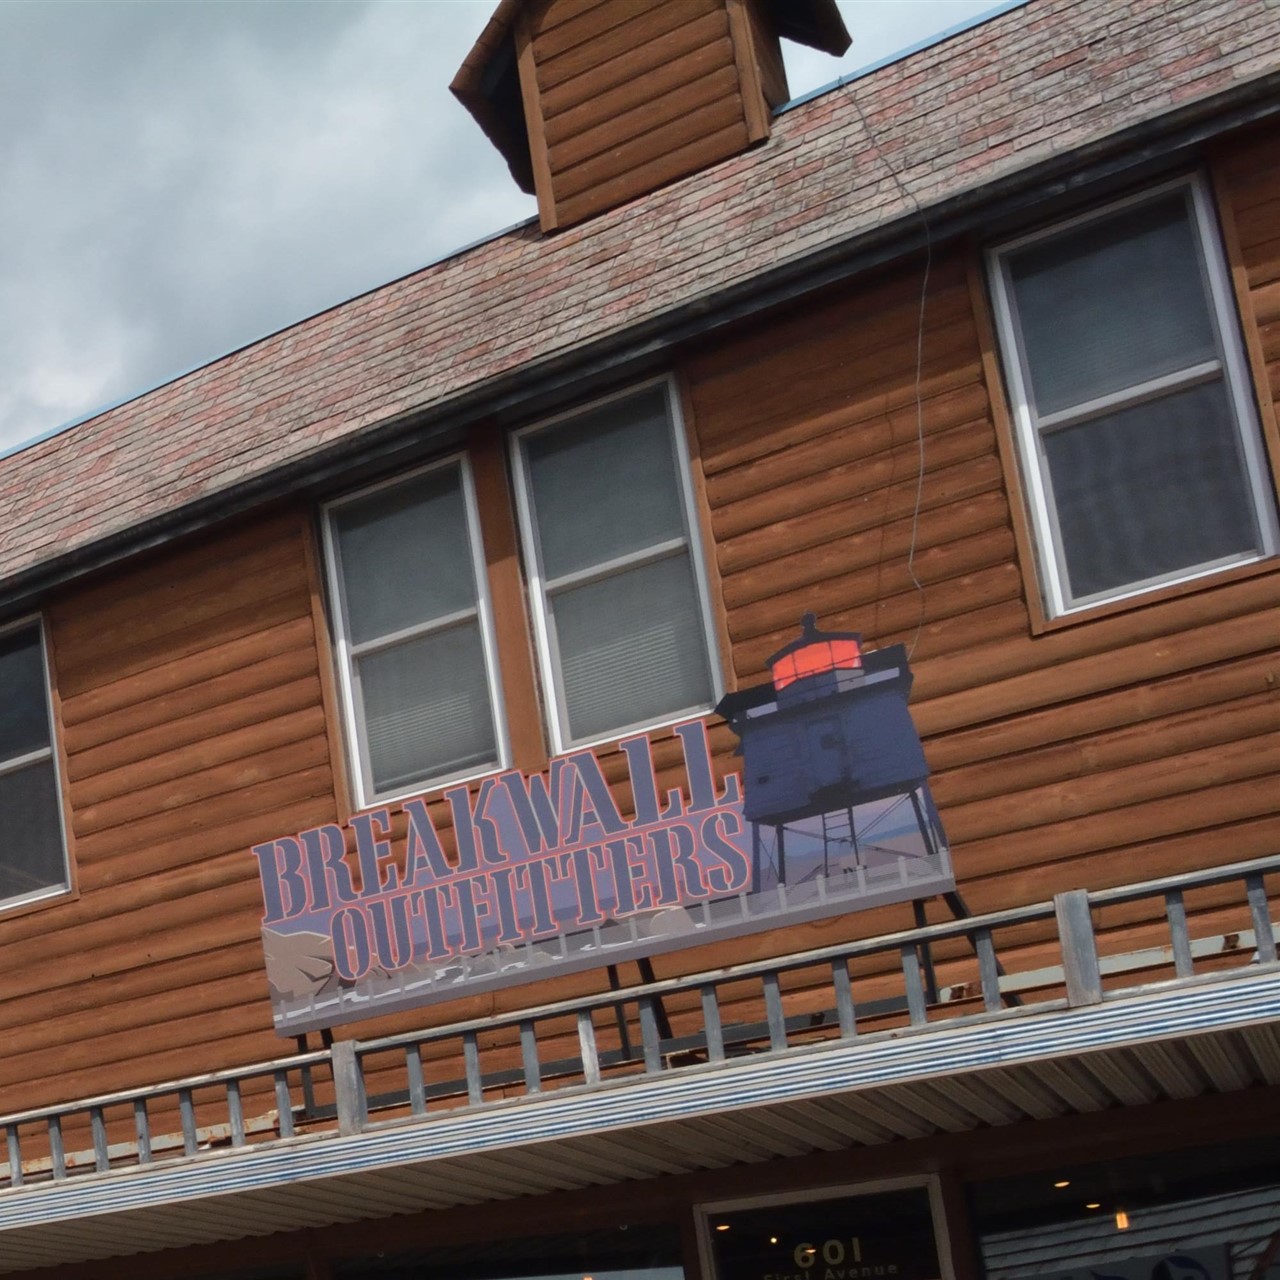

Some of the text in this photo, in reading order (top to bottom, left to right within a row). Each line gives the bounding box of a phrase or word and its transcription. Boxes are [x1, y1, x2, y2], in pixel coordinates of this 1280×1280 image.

[251, 718, 744, 924] BREAKWALL
[328, 810, 753, 981] OUTFITTERS
[793, 1236, 862, 1269] 601
[824, 1263, 898, 1280] Avenue
